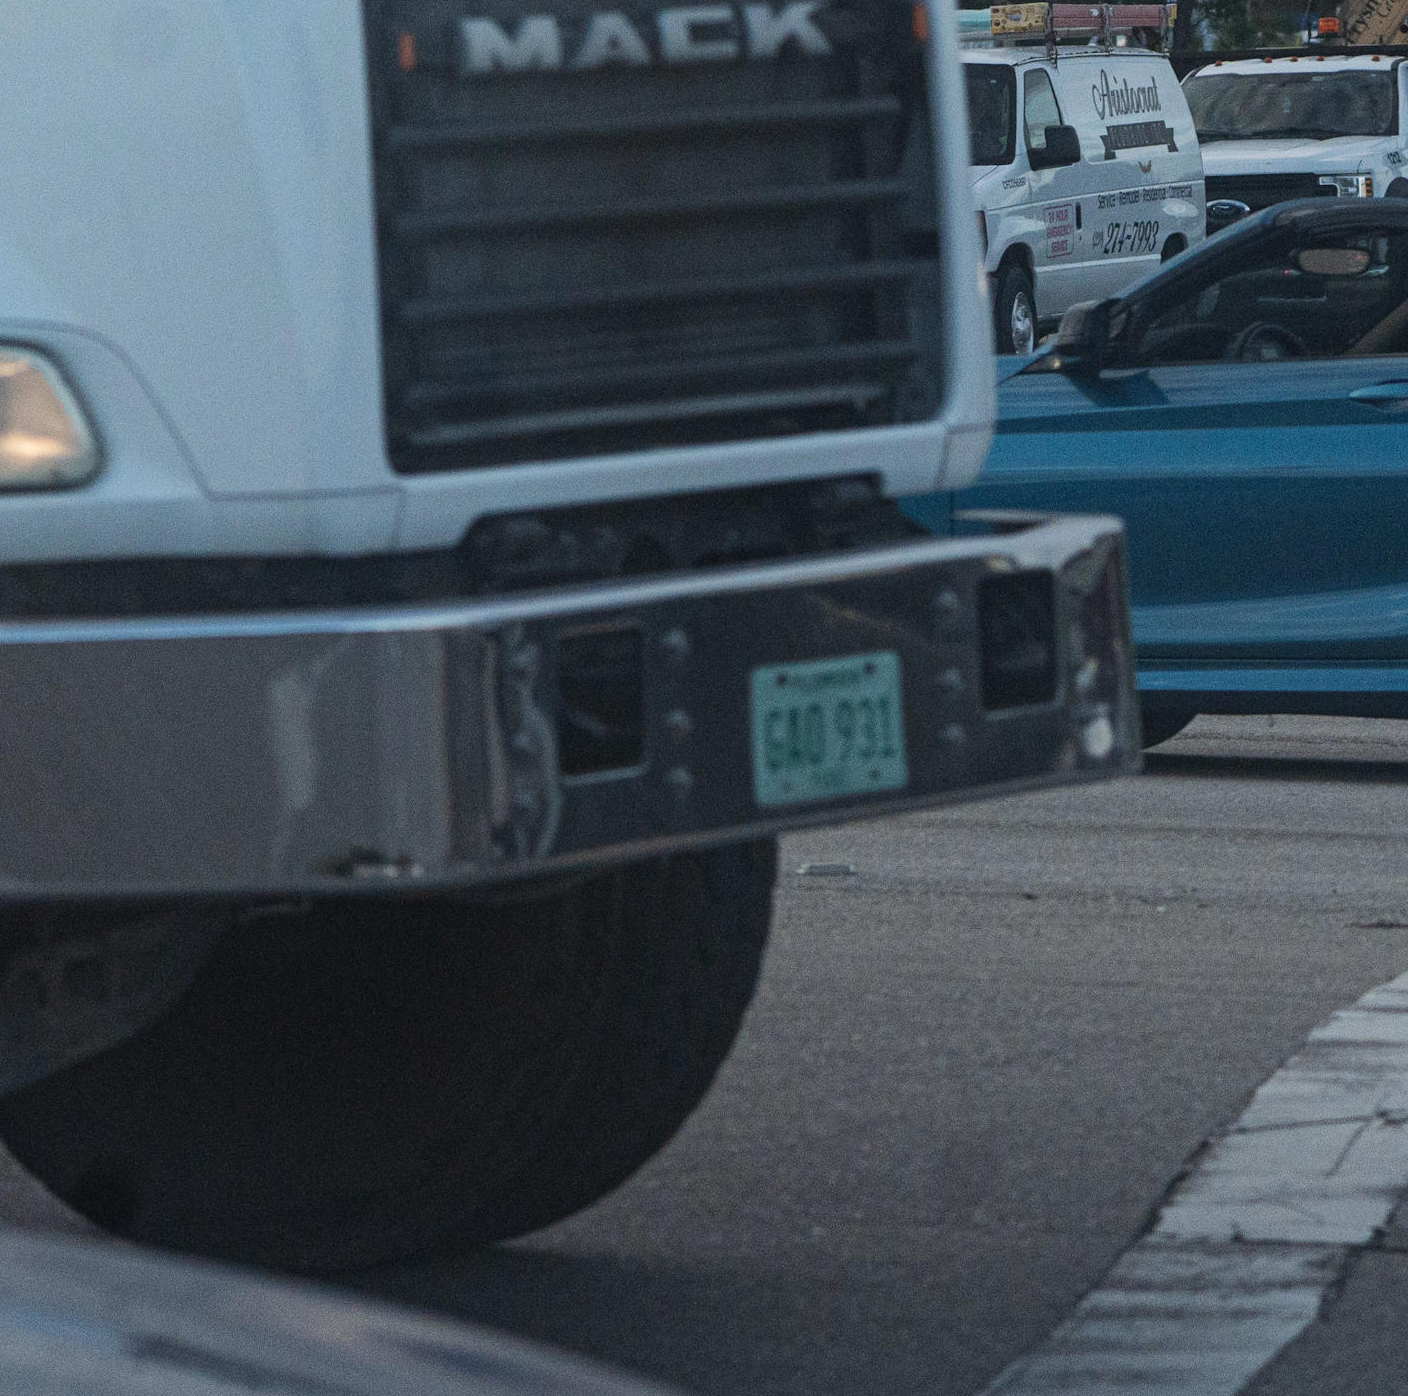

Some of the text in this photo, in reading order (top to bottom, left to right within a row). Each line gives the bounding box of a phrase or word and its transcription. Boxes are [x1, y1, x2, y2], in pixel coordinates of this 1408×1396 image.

[458, 0, 834, 74] MACK
[1091, 68, 1162, 121] Aristocrat
[1103, 220, 1159, 255] 274-7993
